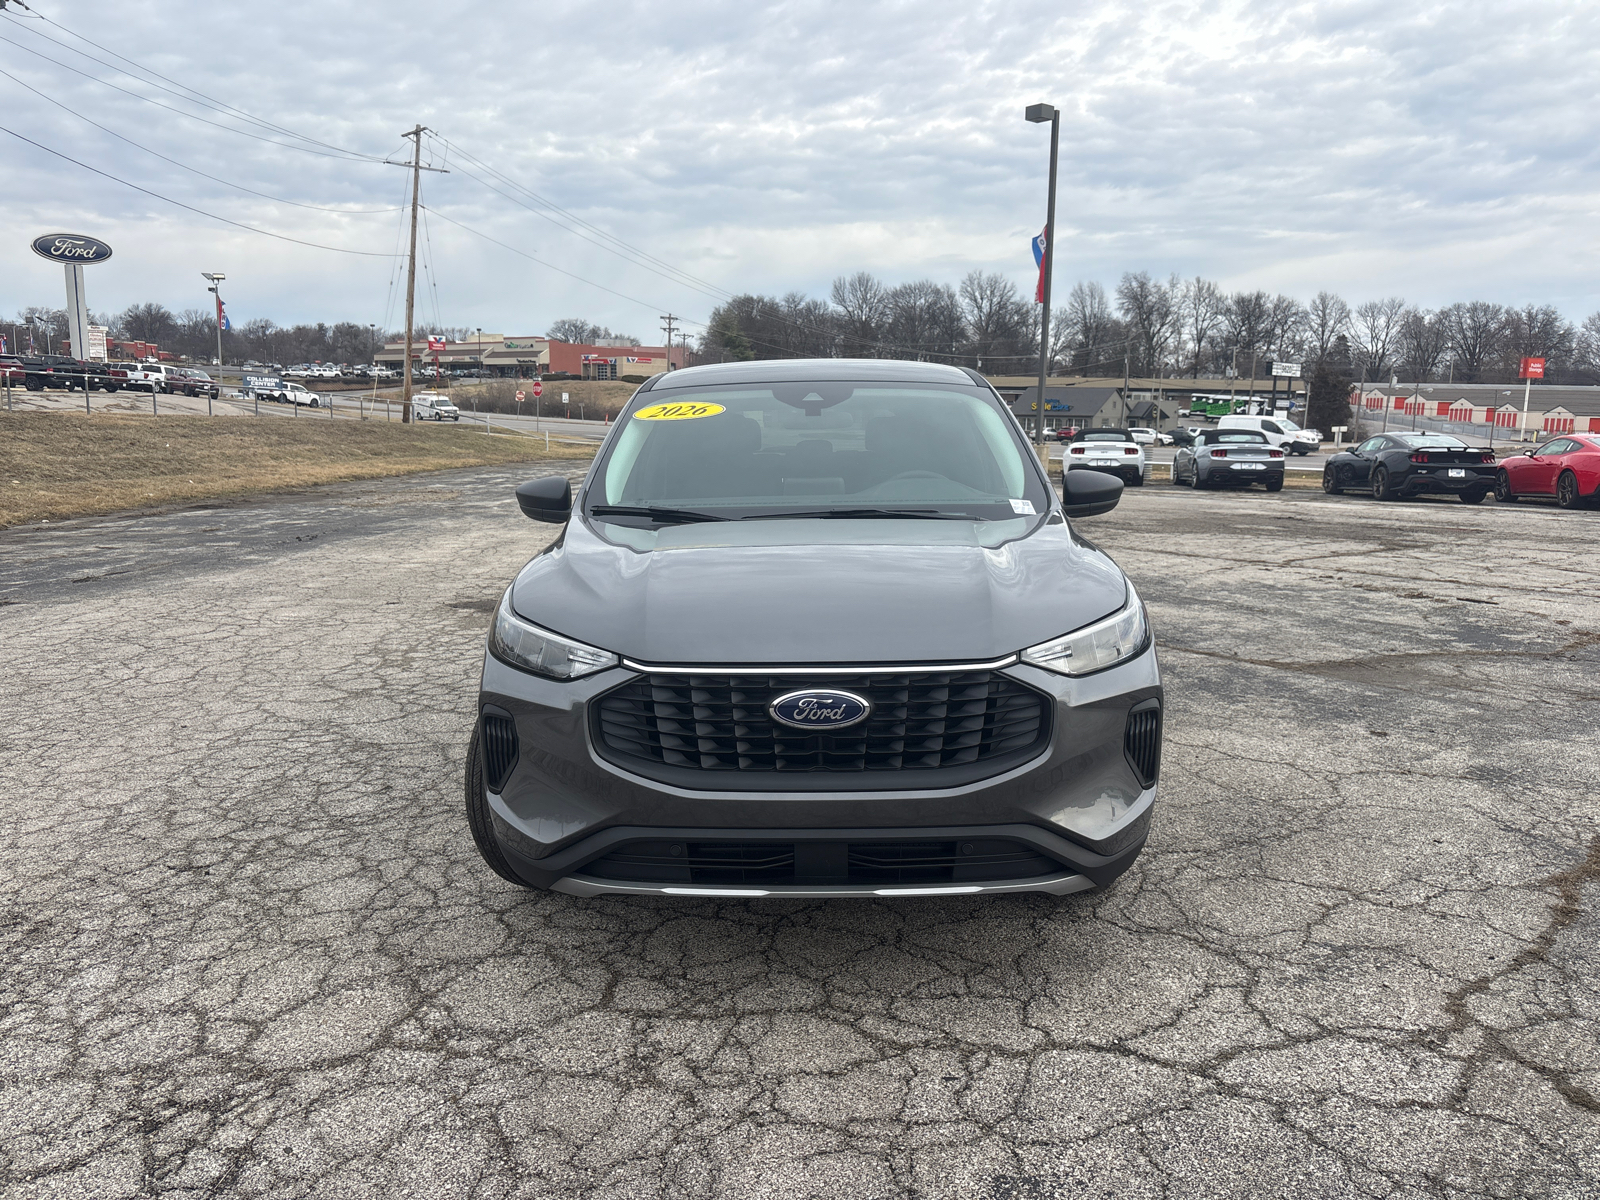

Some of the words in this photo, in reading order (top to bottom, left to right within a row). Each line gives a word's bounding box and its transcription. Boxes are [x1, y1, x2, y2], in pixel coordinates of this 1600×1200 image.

[51, 238, 97, 258] Ford
[532, 385, 542, 393] STOP
[646, 405, 711, 418] 2026
[1031, 402, 1051, 411] Sle
[793, 698, 846, 720] Ford
